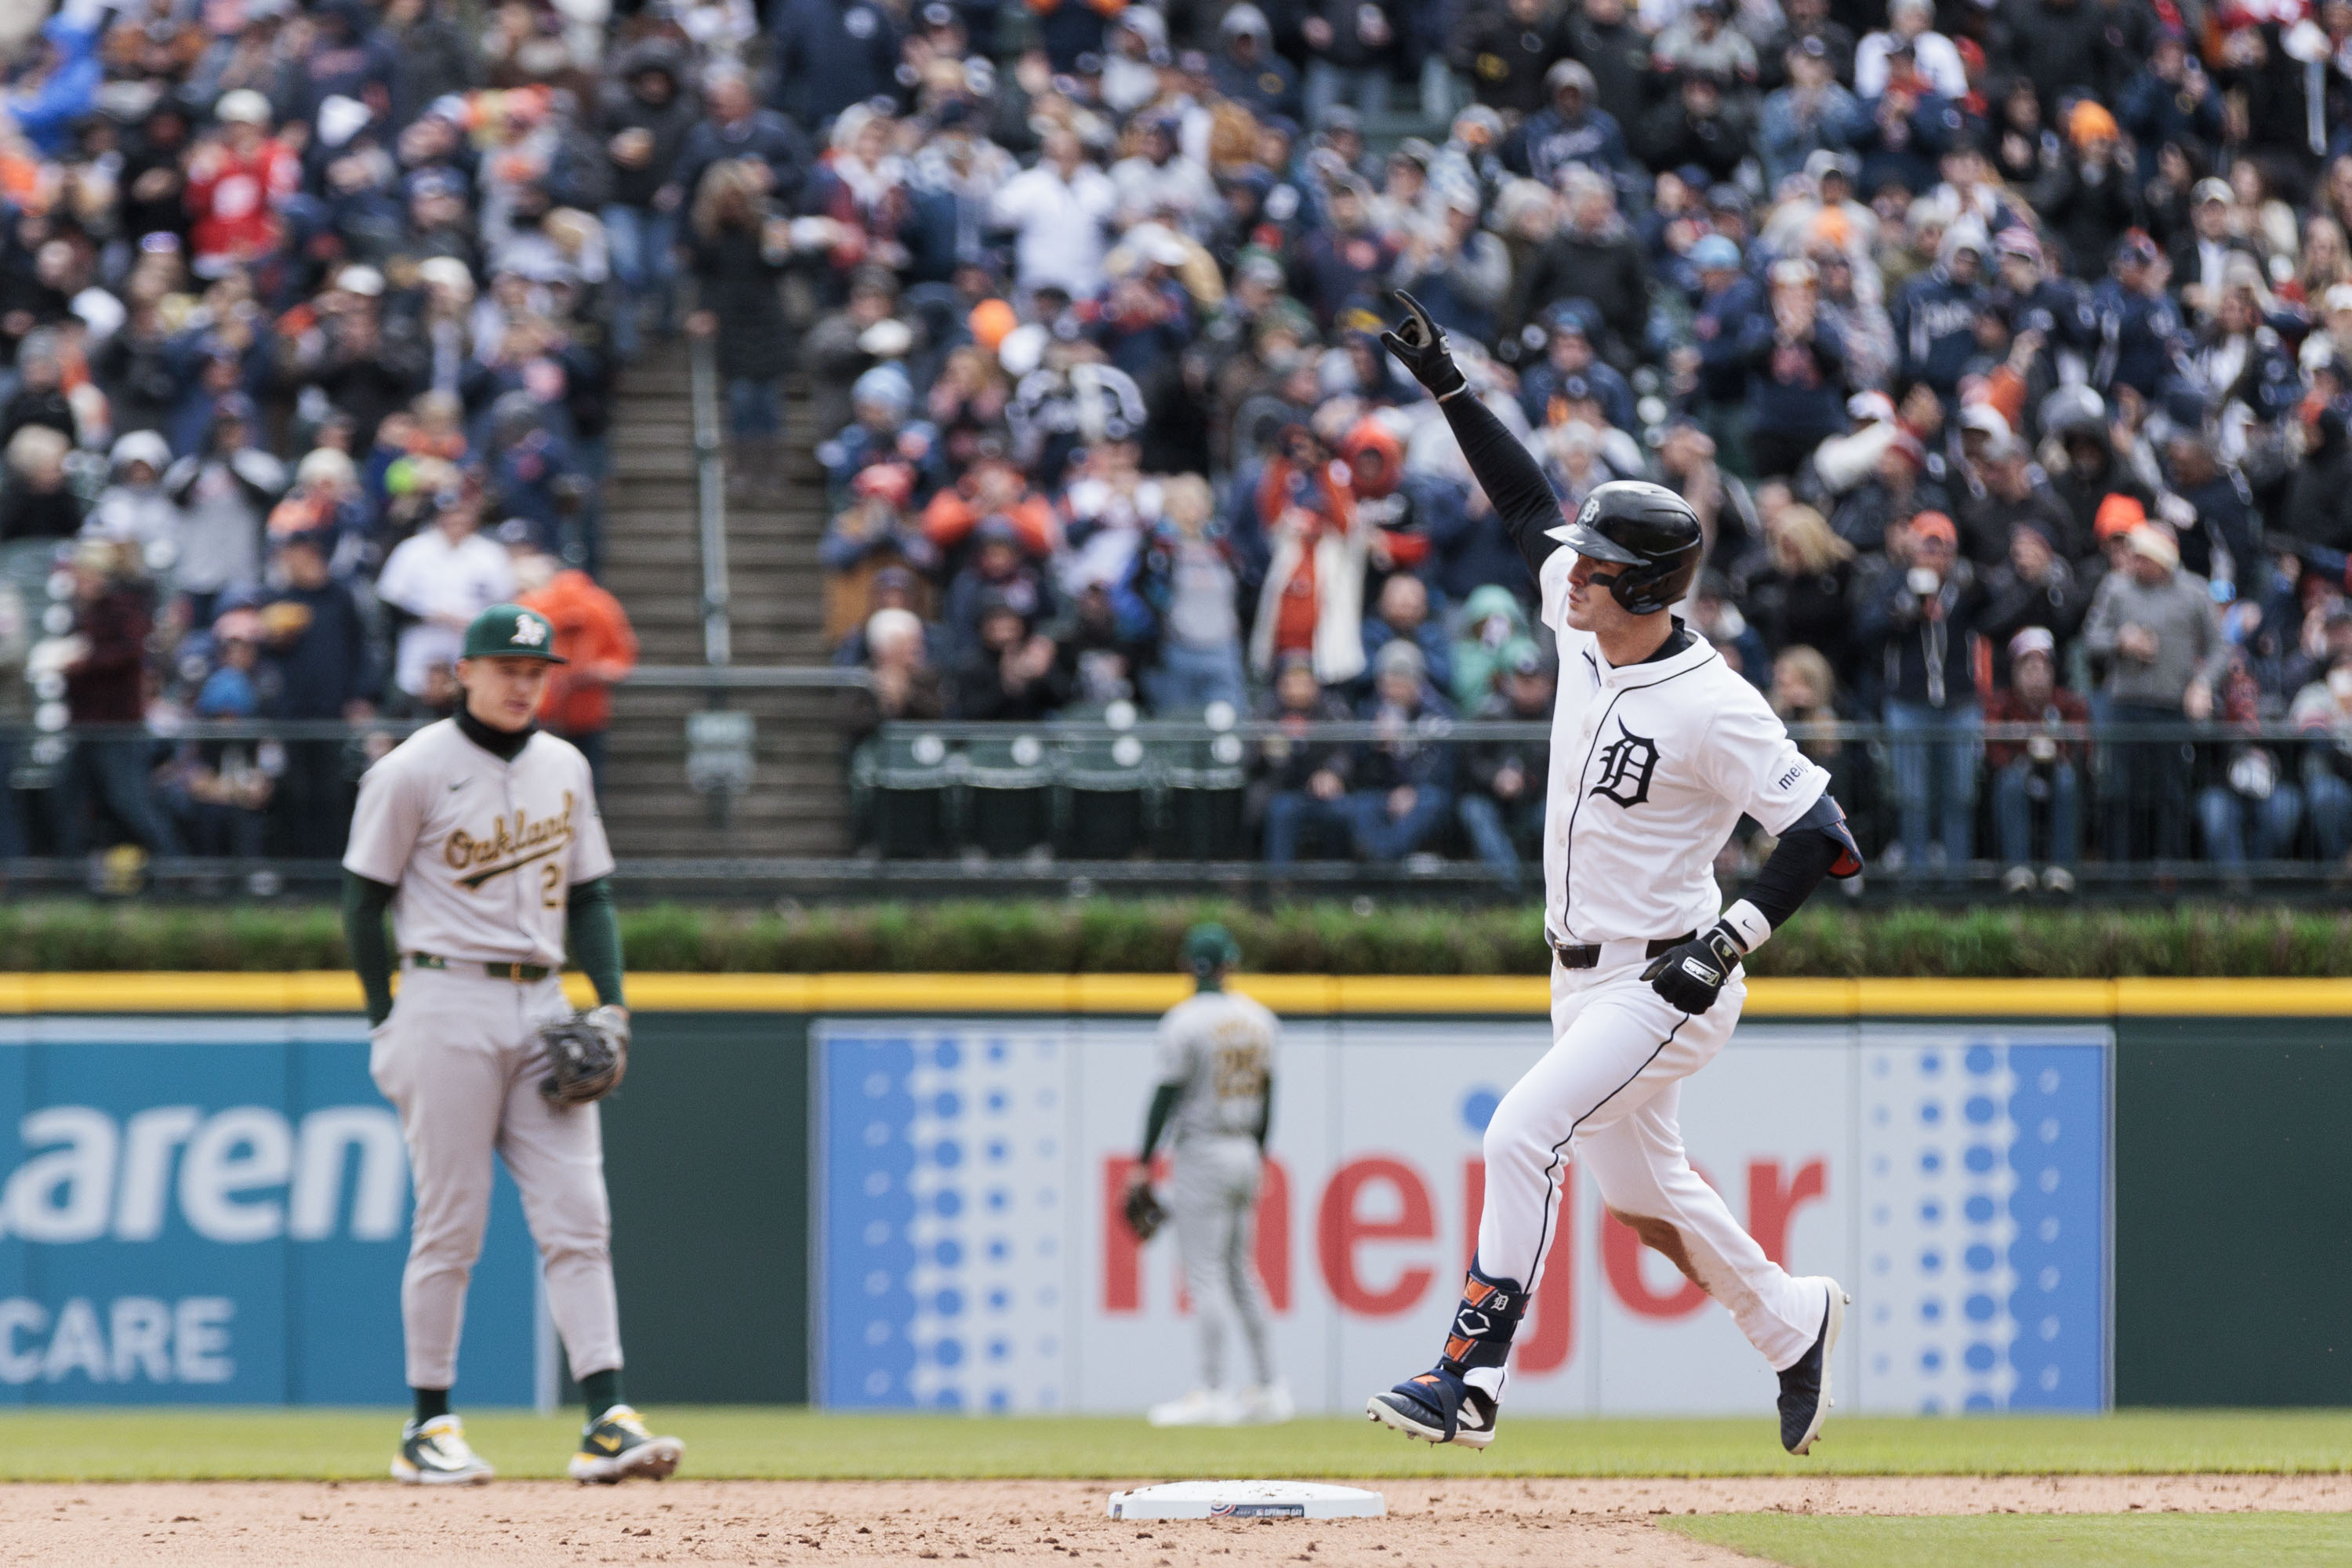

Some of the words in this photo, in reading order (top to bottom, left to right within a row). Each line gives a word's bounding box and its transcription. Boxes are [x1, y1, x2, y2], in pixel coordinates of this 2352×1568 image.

[1588, 713, 1661, 809] D
[444, 789, 575, 870] Oakland
[0, 1106, 412, 1243] aren
[0, 1298, 234, 1383] CARE
[1490, 1292, 1510, 1311] D
